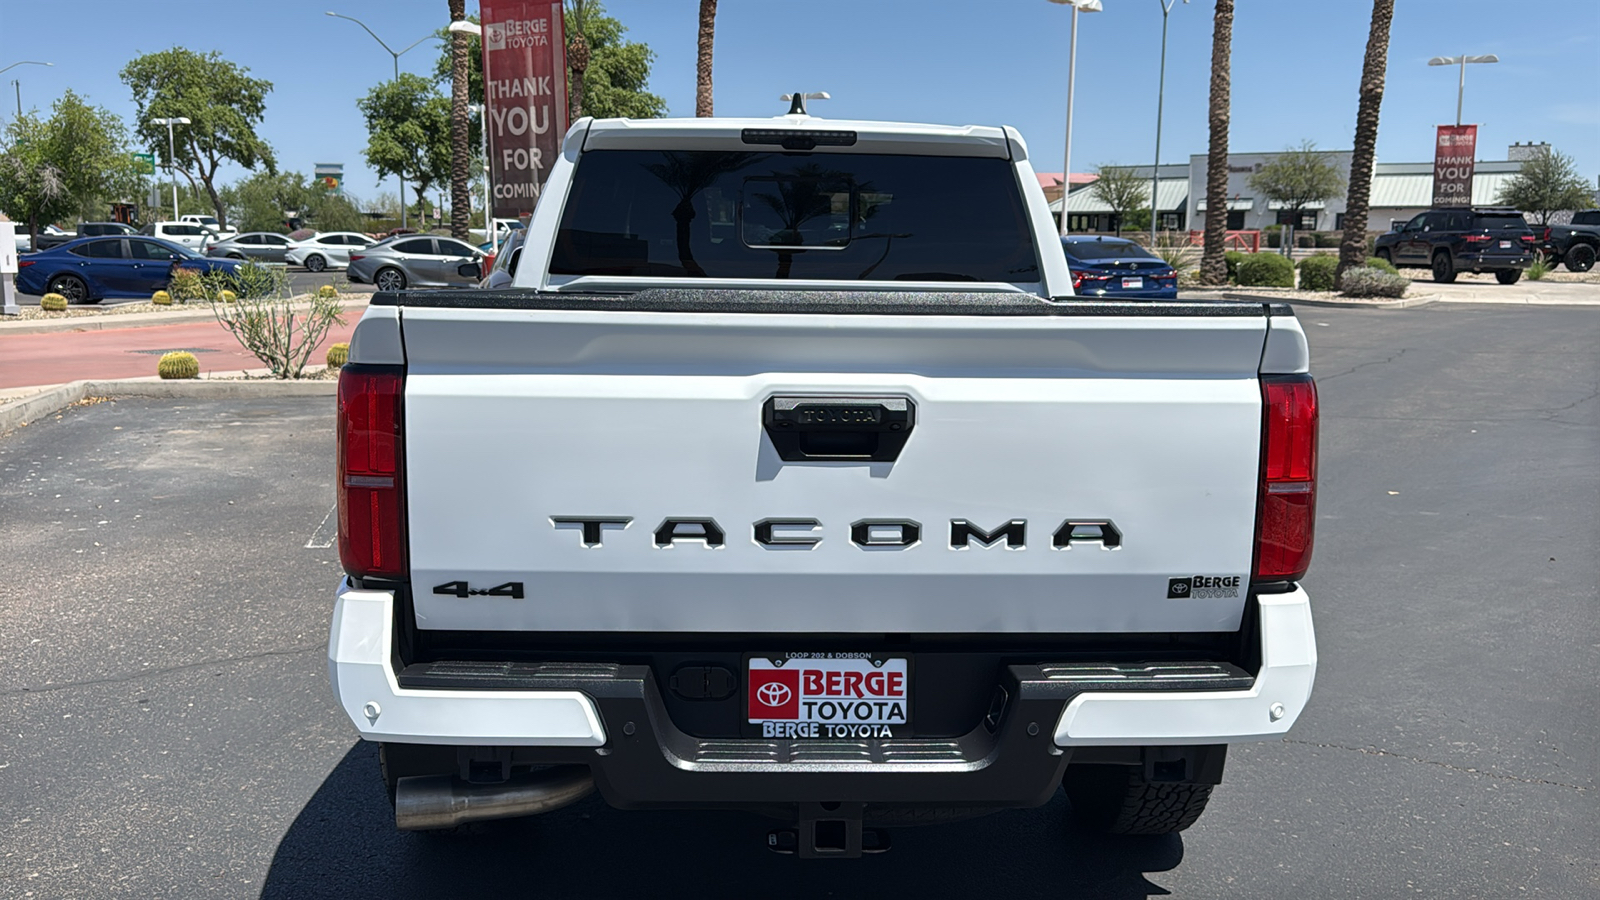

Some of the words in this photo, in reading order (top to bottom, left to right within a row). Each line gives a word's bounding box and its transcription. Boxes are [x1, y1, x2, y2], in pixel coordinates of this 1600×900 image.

[506, 18, 548, 36] BERGE
[507, 35, 548, 49] TOYOTA
[489, 76, 551, 99] THANK
[491, 105, 549, 137] YOU
[503, 147, 544, 171] FOR
[1437, 156, 1472, 165] THANK
[1437, 167, 1470, 179] YOU
[1440, 183, 1464, 193] FOR
[1433, 196, 1470, 204] COMING!
[803, 409, 877, 422] TOYOTA
[548, 514, 1123, 552] TACOMA
[1192, 575, 1240, 588] BERGE
[1191, 588, 1239, 599] TOYOTA
[803, 669, 904, 699] BERGE
[803, 701, 905, 721] TOYOTA
[762, 721, 820, 740] BERGE
[825, 724, 893, 738] TOYOTA
